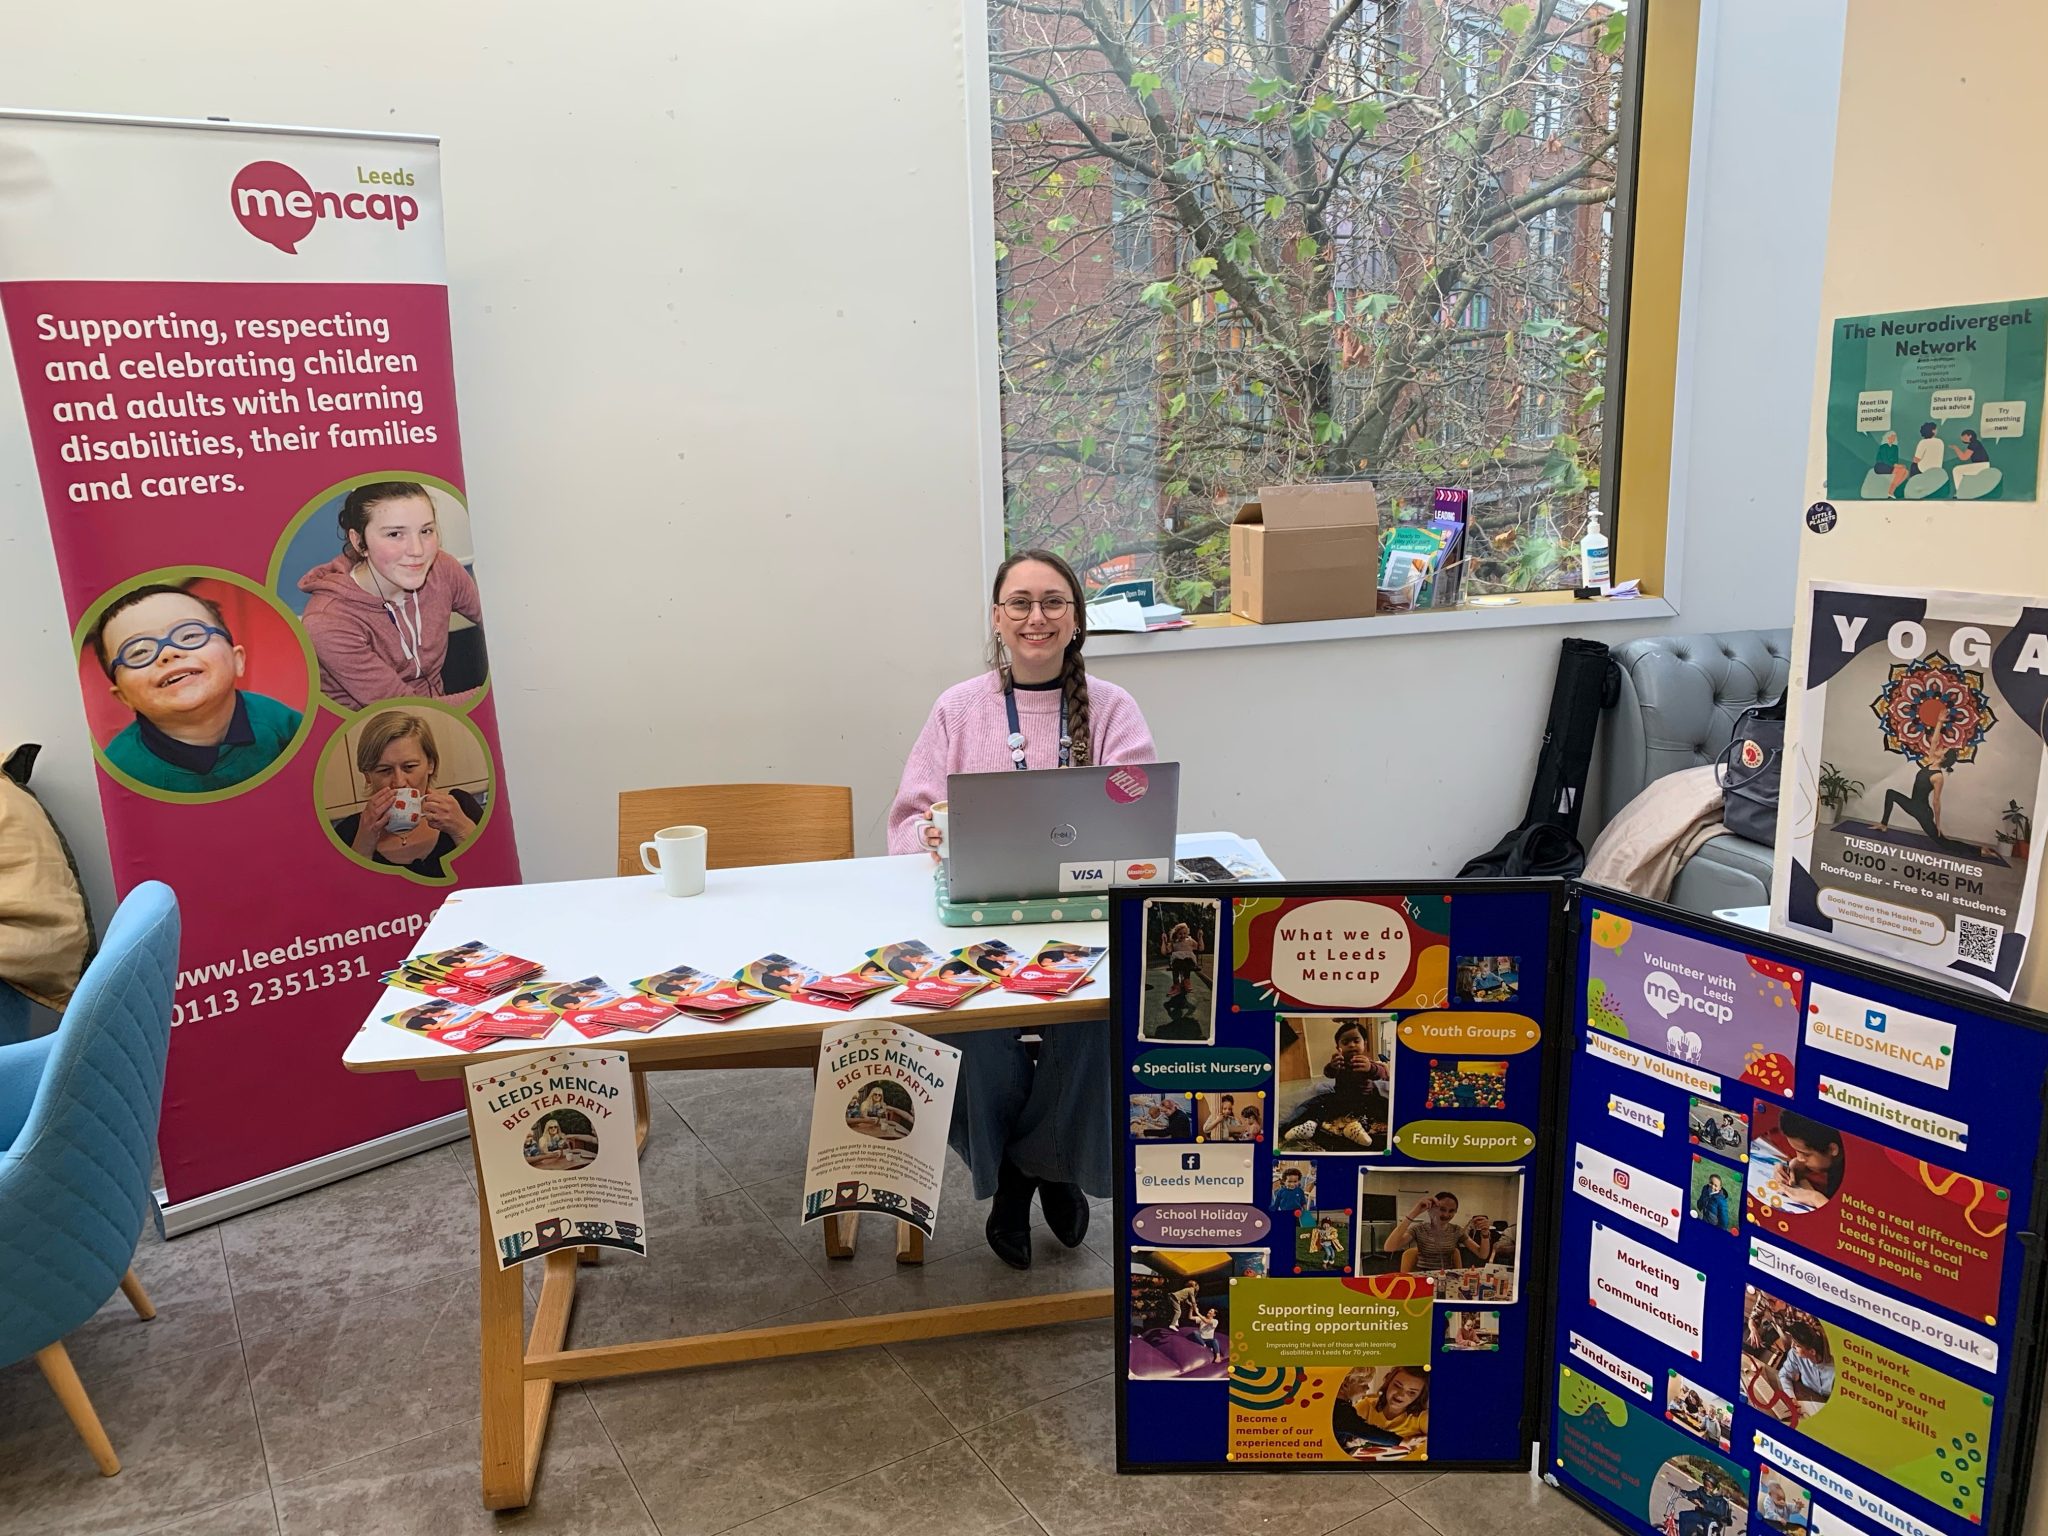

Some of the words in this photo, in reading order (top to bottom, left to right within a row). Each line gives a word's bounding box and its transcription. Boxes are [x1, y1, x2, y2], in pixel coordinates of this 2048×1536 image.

[357, 166, 415, 186] Leeds
[237, 187, 418, 230] mencap
[36, 312, 227, 346] Supporting,
[235, 312, 390, 343] respecting
[1843, 323, 1876, 340] The
[1881, 308, 2032, 337] Neurodivergent
[1896, 336, 1977, 357] Network
[45, 353, 109, 381] and
[118, 350, 295, 382] celebrating
[304, 350, 418, 375] children
[53, 394, 117, 422] and
[126, 391, 226, 419] adults
[232, 390, 300, 416] with
[307, 385, 424, 415] learning
[60, 434, 244, 463] disabilities,
[249, 426, 320, 452] their
[327, 421, 438, 448] families
[68, 473, 131, 502] and
[140, 471, 245, 498] carers.
[1435, 510, 1455, 520] LEADING
[1109, 770, 1146, 798] HELLO
[1127, 868, 1156, 876] MasterCard
[1842, 851, 1886, 872] 01:00
[1903, 865, 1950, 887] 01:45
[1955, 877, 1984, 896] PM
[1844, 836, 1898, 857] TUESDAY
[1900, 850, 1983, 878] LUNCHTIMES
[1071, 869, 1103, 880] VISA
[1820, 863, 1862, 881] Rooftop
[1864, 873, 1882, 886] Bar
[1893, 881, 1918, 894] Free
[1921, 887, 1934, 898] to
[1936, 892, 1950, 902] all
[1952, 896, 2007, 917] students
[1827, 894, 1846, 905] Book
[1848, 901, 1863, 910] now
[1865, 904, 1875, 912] on
[1876, 907, 1890, 916] the
[1891, 911, 1918, 926] Health
[1919, 917, 1935, 928] and
[1838, 907, 1875, 924] Wellbeing
[1876, 917, 1900, 930] Space
[1902, 924, 1922, 935] page
[1280, 928, 1334, 942] What
[1343, 930, 1370, 941] we
[1381, 927, 1404, 941] do
[1296, 948, 1318, 961] at
[1327, 948, 1387, 961] Leeds
[1644, 952, 1705, 980] Volunteer
[1708, 974, 1736, 991] with
[170, 989, 240, 1028] 0113
[249, 955, 370, 1006] 2351331
[1302, 968, 1381, 983] Mencap
[1648, 981, 1733, 1024] mencap
[1704, 986, 1733, 1003] Leeds
[1421, 1025, 1463, 1038] Youth
[1467, 1026, 1517, 1040] Groups
[1813, 1021, 1945, 1071] @LEEDSMENCAP
[1592, 1034, 1639, 1066] Nursery
[831, 1048, 879, 1073] LEEDS
[884, 1049, 945, 1090] MENCAP
[836, 1072, 862, 1090] BIG
[864, 1064, 892, 1077] TEA
[896, 1068, 934, 1105] PARTY
[1143, 1061, 1207, 1075] Specialist
[1210, 1061, 1262, 1075] Nursery
[488, 1081, 543, 1113] LEEDS
[549, 1077, 619, 1100] MENCAP
[502, 1107, 530, 1131] BIG
[531, 1094, 562, 1112] TEA
[567, 1094, 612, 1120] PARTY
[1615, 1100, 1659, 1129] Events
[1825, 1084, 1960, 1143] Administration
[1412, 1133, 1460, 1148] Family
[1463, 1134, 1518, 1148] Support
[1141, 1175, 1191, 1187] @Leeds
[1195, 1174, 1245, 1188] Mencap
[1155, 1209, 1197, 1221] School
[1200, 1209, 1249, 1223] Holiday
[1578, 1176, 1668, 1227] @leeds.mencap
[1160, 1226, 1243, 1239] Playschemes
[1841, 1208, 1853, 1221] to
[1856, 1214, 1877, 1230] the
[1881, 1224, 1909, 1245] lives
[1913, 1240, 1926, 1251] of
[1931, 1244, 1963, 1266] local
[1842, 1193, 1874, 1215] Make
[1878, 1210, 1885, 1219] a
[1889, 1214, 1914, 1231] real
[1918, 1225, 1988, 1260] difference
[1837, 1239, 1875, 1263] young
[1879, 1256, 1922, 1281] people
[1840, 1222, 1875, 1245] Leeds
[1878, 1239, 1930, 1269] families
[1933, 1264, 1959, 1281] and
[1617, 1249, 1680, 1290] Marketing
[1635, 1280, 1658, 1297] and
[1258, 1303, 1334, 1318] Supporting
[1338, 1303, 1400, 1317] learning,
[1597, 1278, 1699, 1336] Communications
[1776, 1257, 1980, 1356] info@leedsmencap.org.uk
[1252, 1320, 1311, 1334] Creating
[1315, 1319, 1409, 1334] opportunities
[1266, 1342, 1299, 1350] Improving
[1370, 1341, 1397, 1349] learning
[1843, 1339, 1872, 1359] Gain
[1877, 1356, 1910, 1377] work
[1574, 1338, 1648, 1394] Fundraising
[1842, 1356, 1915, 1396] experience
[1919, 1392, 1946, 1410] and
[1841, 1370, 1893, 1402] develop
[1896, 1397, 1928, 1418] your
[1236, 1414, 1278, 1423] Become
[1840, 1386, 1898, 1420] personal
[1901, 1416, 1937, 1439] skills
[1235, 1438, 1300, 1448] experienced
[1303, 1438, 1323, 1447] and
[1236, 1427, 1280, 1435] member
[1282, 1427, 1294, 1435] of
[1235, 1451, 1293, 1460] passionate
[1760, 1436, 1853, 1501] Playscheme
[1858, 1495, 1931, 1536] volunte
